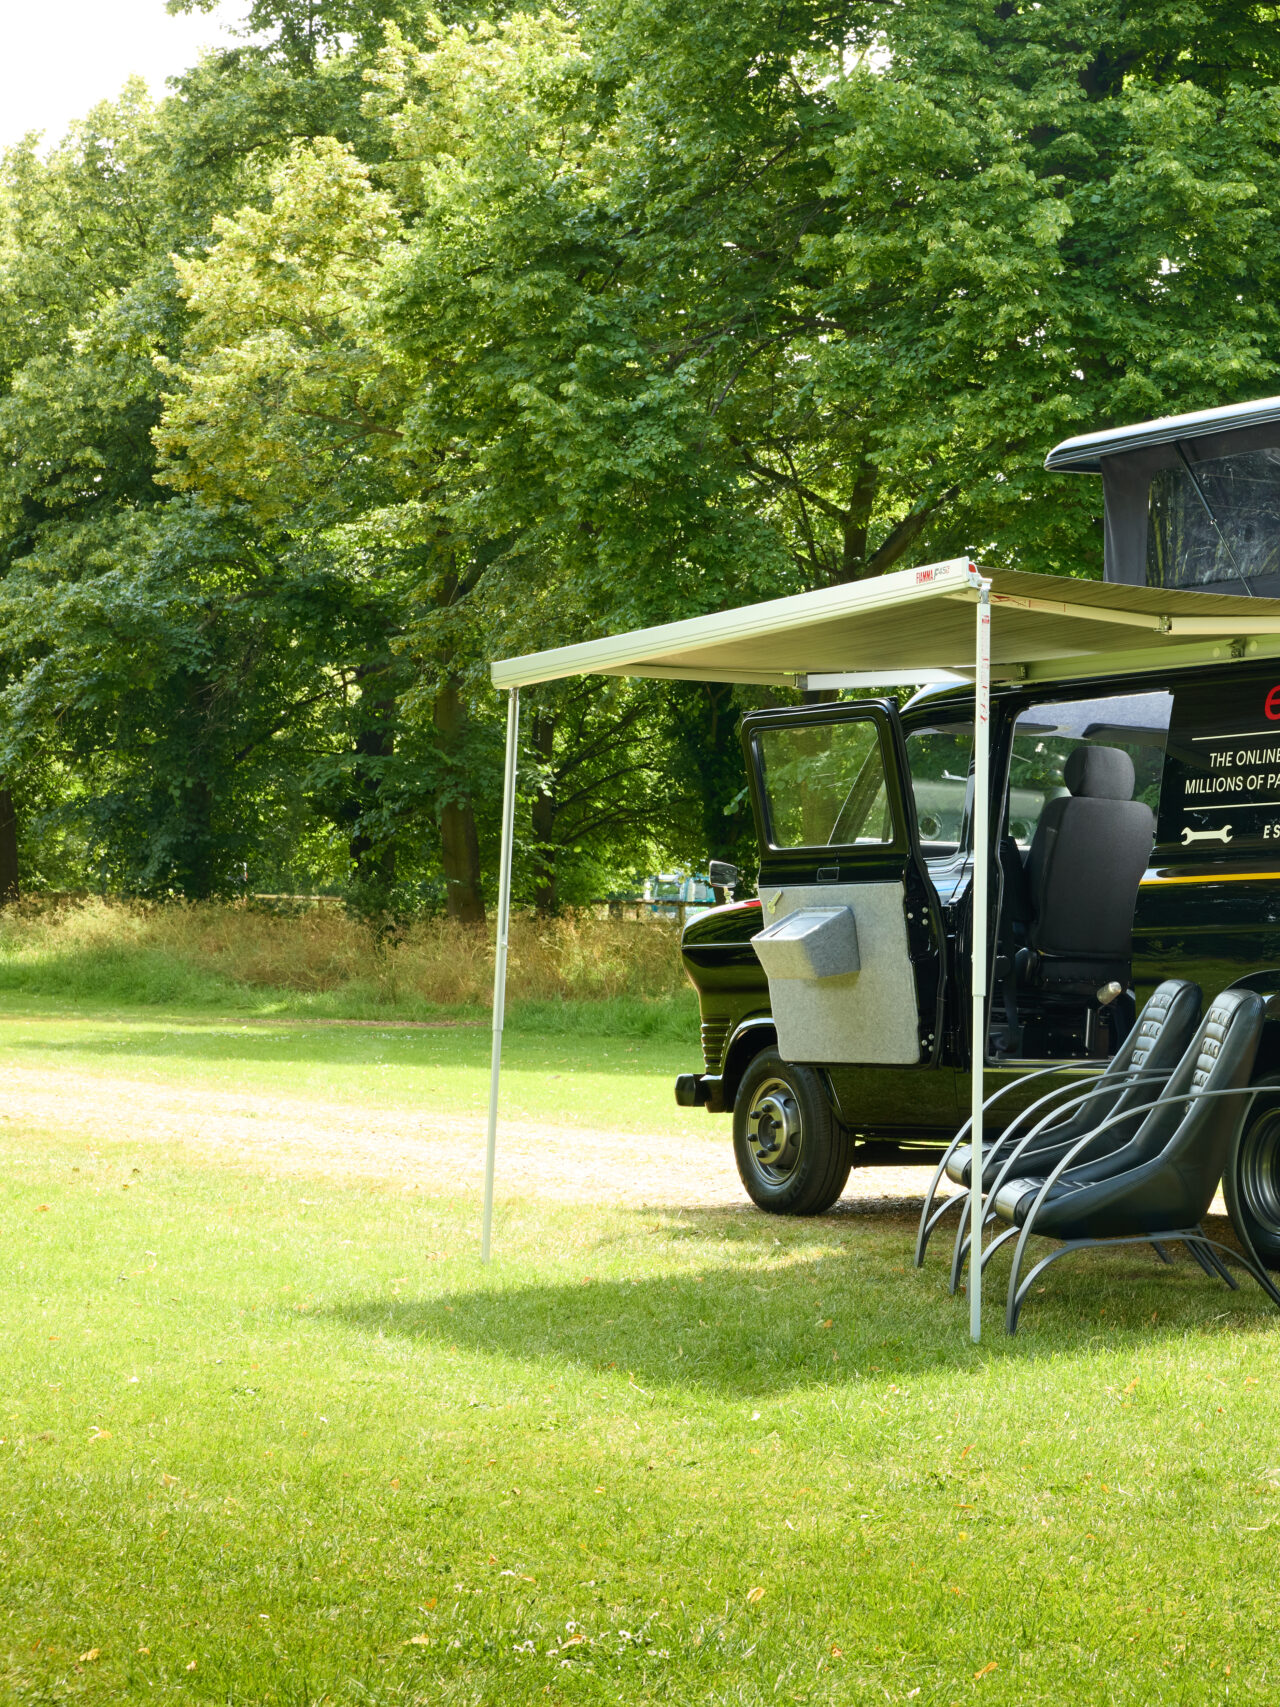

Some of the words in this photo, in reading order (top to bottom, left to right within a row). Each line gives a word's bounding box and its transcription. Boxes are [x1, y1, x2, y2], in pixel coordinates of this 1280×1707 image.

[916, 569, 933, 584] FIAMMA
[1209, 752, 1233, 767] THE
[1184, 776, 1243, 795] MILLIONS
[1246, 774, 1264, 791] OF
